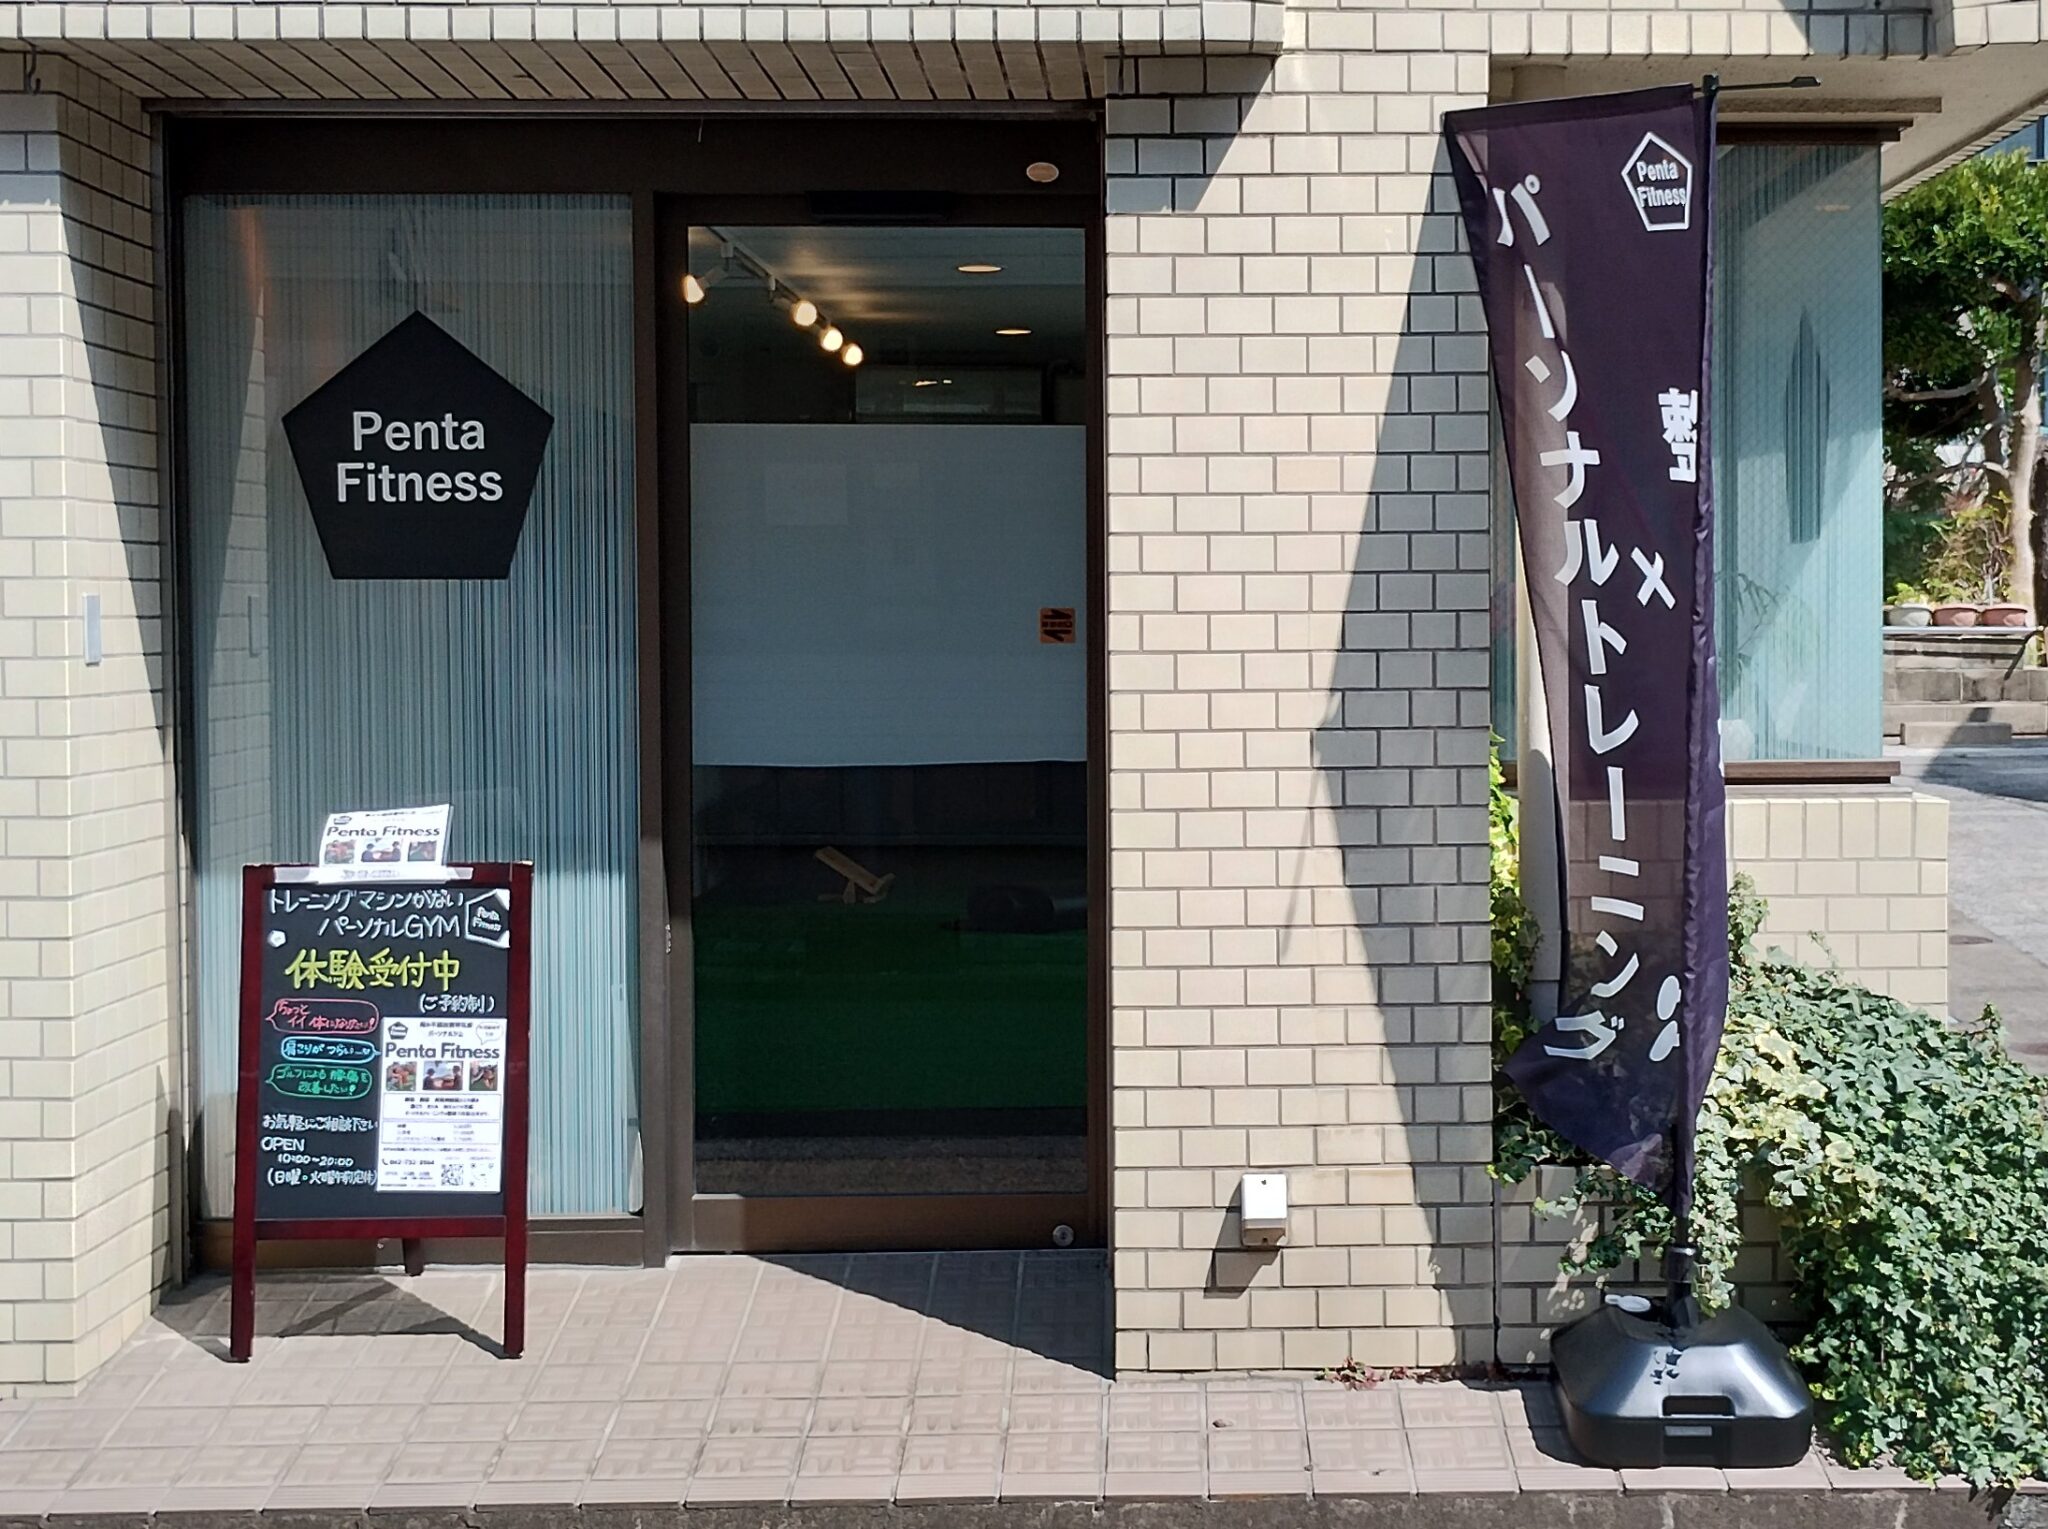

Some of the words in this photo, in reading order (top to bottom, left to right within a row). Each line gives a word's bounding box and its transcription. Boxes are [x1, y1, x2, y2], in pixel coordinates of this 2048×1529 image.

[1636, 159, 1679, 182] Penta
[1637, 186, 1687, 208] Fitness
[353, 411, 485, 451] Penta
[337, 462, 503, 502] Fitness
[1493, 174, 1644, 1061] パーソナルトレーニング
[326, 826, 377, 837] Penta
[382, 825, 440, 836] Fitness
[318, 914, 461, 940] パーソナルGYM
[284, 947, 460, 991] 体験受付中
[385, 1042, 437, 1058] Penta
[441, 1042, 500, 1059] Fitness
[260, 1136, 305, 1152] OPEN
